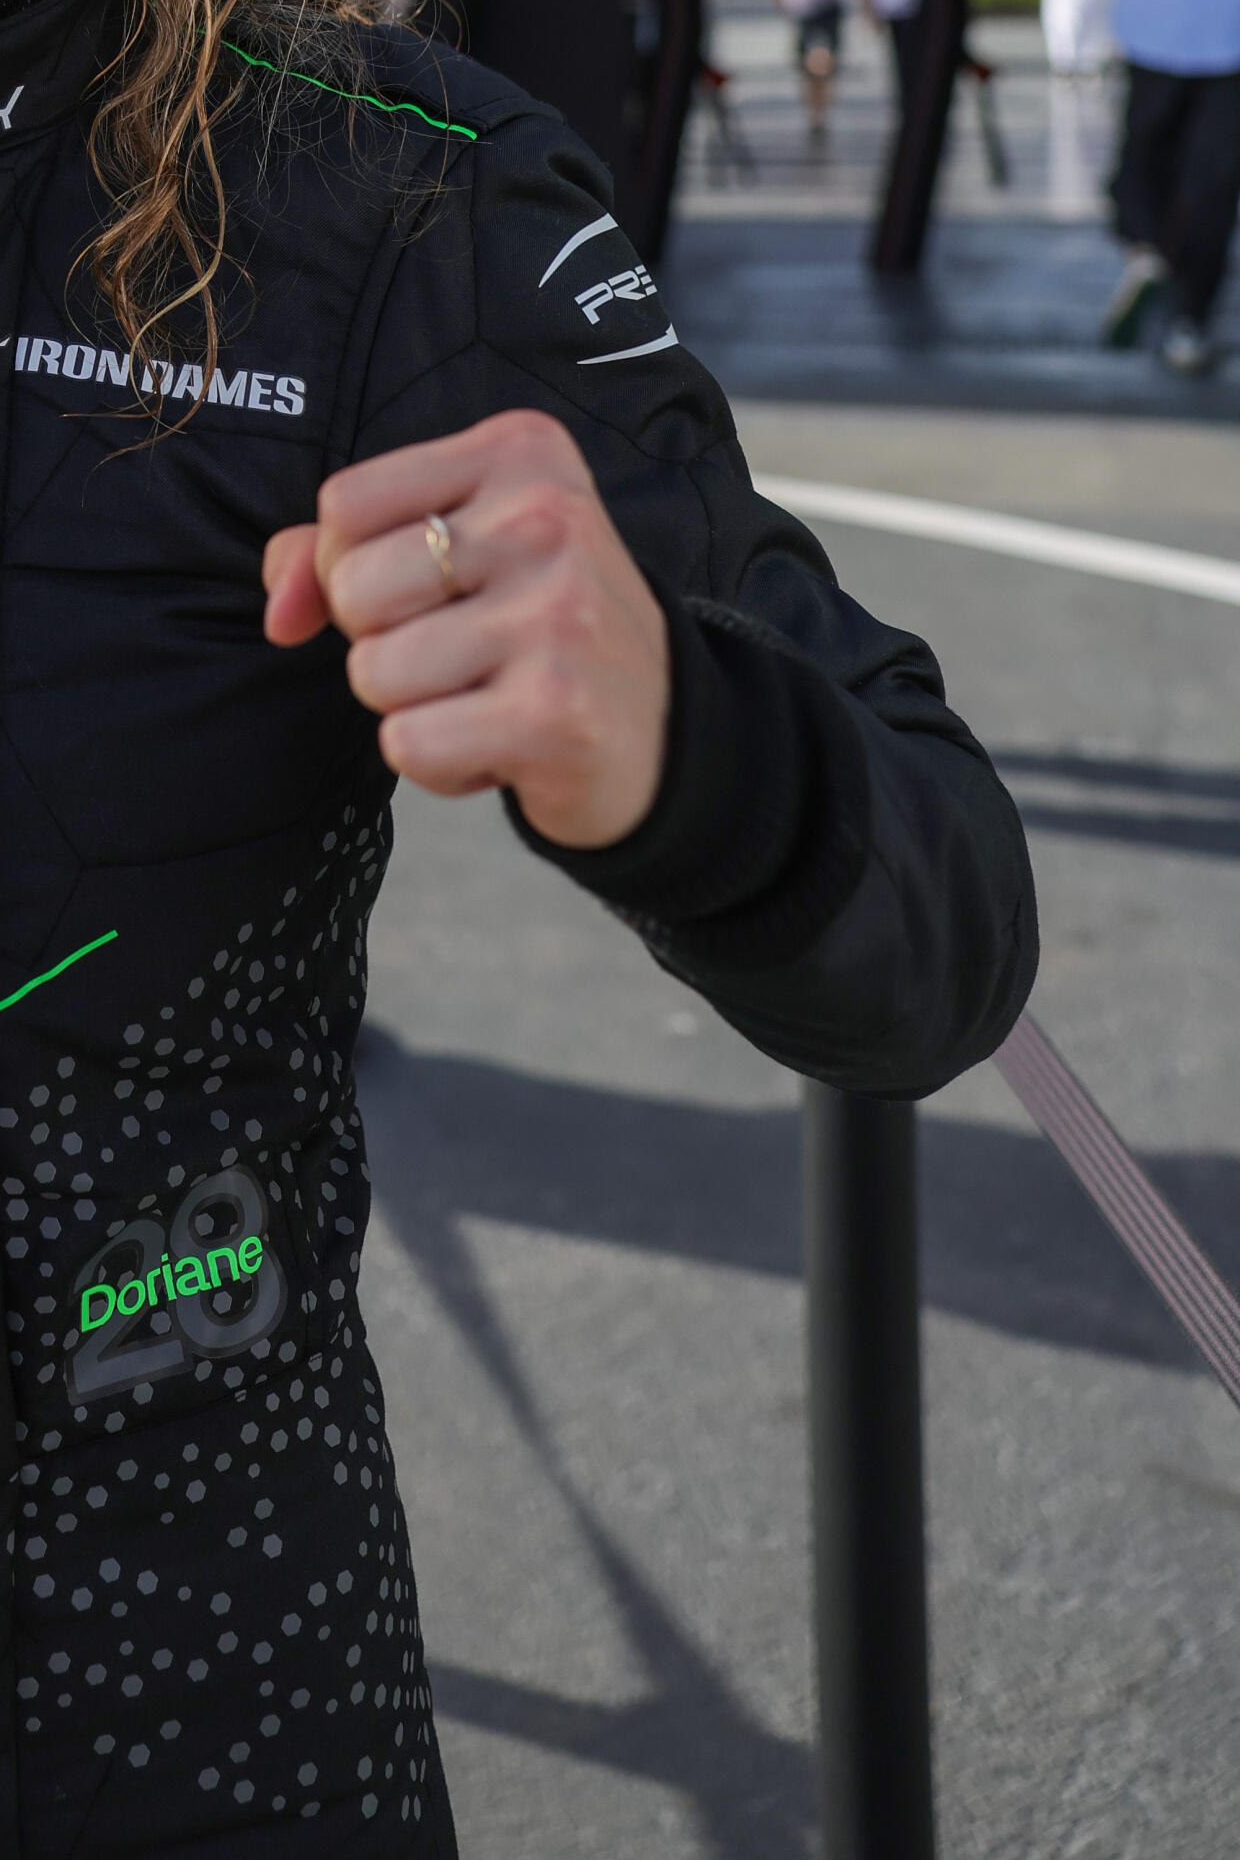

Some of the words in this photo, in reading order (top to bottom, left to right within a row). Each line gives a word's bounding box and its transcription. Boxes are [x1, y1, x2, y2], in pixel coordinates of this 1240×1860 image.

[14, 336, 131, 387] IRON
[140, 358, 306, 416] DAMES
[80, 1236, 264, 1333] Doriane
